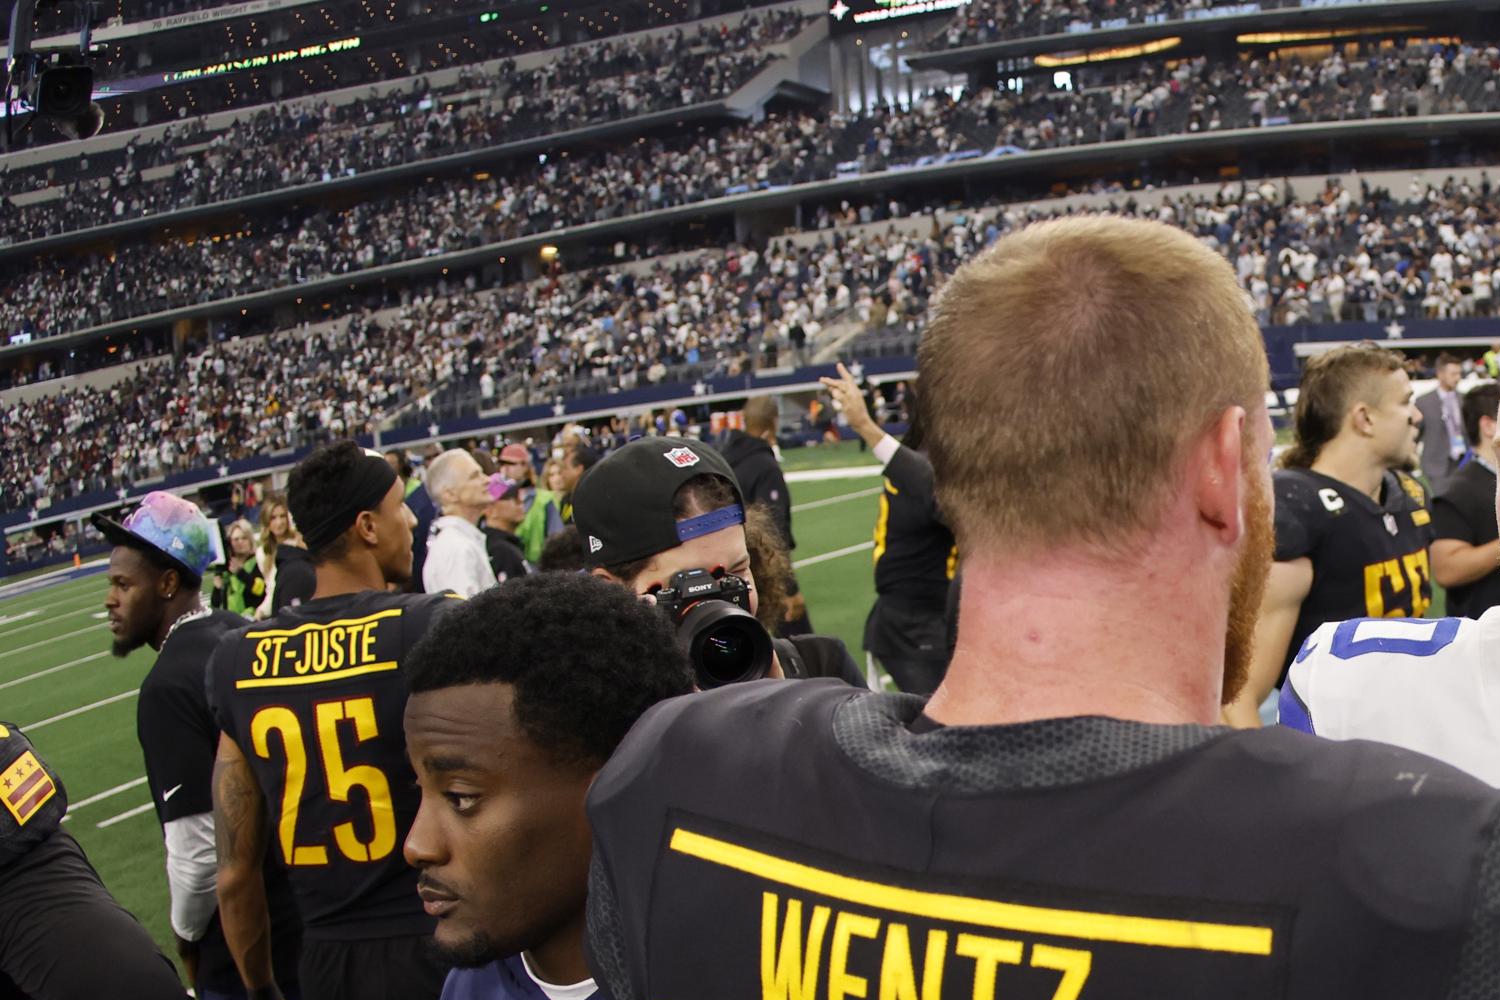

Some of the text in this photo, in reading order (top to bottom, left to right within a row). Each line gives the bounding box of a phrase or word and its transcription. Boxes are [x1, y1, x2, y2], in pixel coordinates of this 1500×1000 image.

[687, 583, 713, 593] SONY
[252, 621, 379, 677] ST-JUSTE
[251, 696, 397, 866] 25
